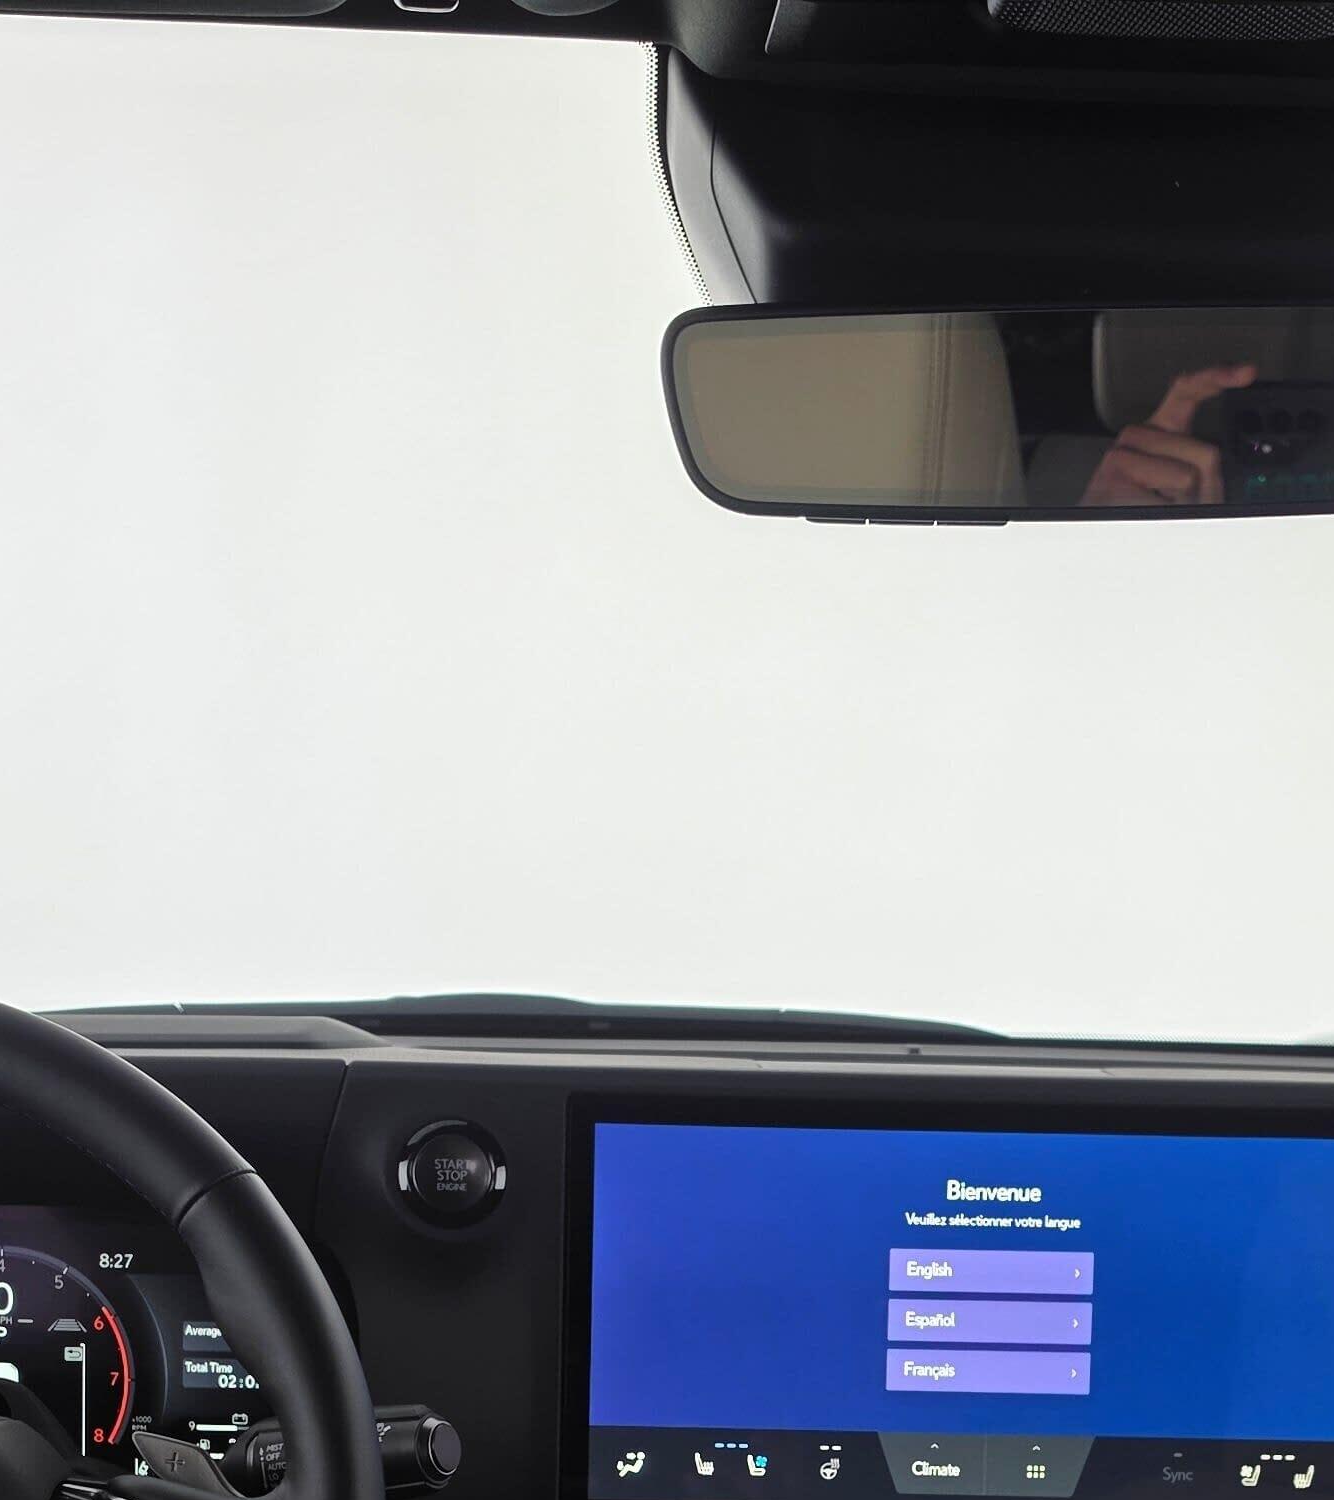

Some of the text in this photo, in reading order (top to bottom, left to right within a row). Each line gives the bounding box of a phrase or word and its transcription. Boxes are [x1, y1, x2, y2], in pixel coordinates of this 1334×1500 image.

[434, 1158, 470, 1170] START
[436, 1169, 467, 1182] STOP
[436, 1182, 467, 1192] ENGINE
[946, 1179, 1042, 1203] Bienvenue
[904, 1211, 1081, 1231] Veuillez sélectionner votre langue
[98, 1253, 134, 1270] 8:27
[906, 1261, 953, 1280] English
[53, 1275, 65, 1290] 5
[93, 1316, 105, 1331] 6
[904, 1310, 956, 1330] Español
[184, 1360, 234, 1374] Total Time
[903, 1360, 956, 1381] Français
[110, 1372, 120, 1387] 7
[218, 1374, 260, 1390] 02:0
[93, 1428, 105, 1444] 8
[911, 1460, 960, 1477] Climate
[1162, 1466, 1193, 1483] Sync
